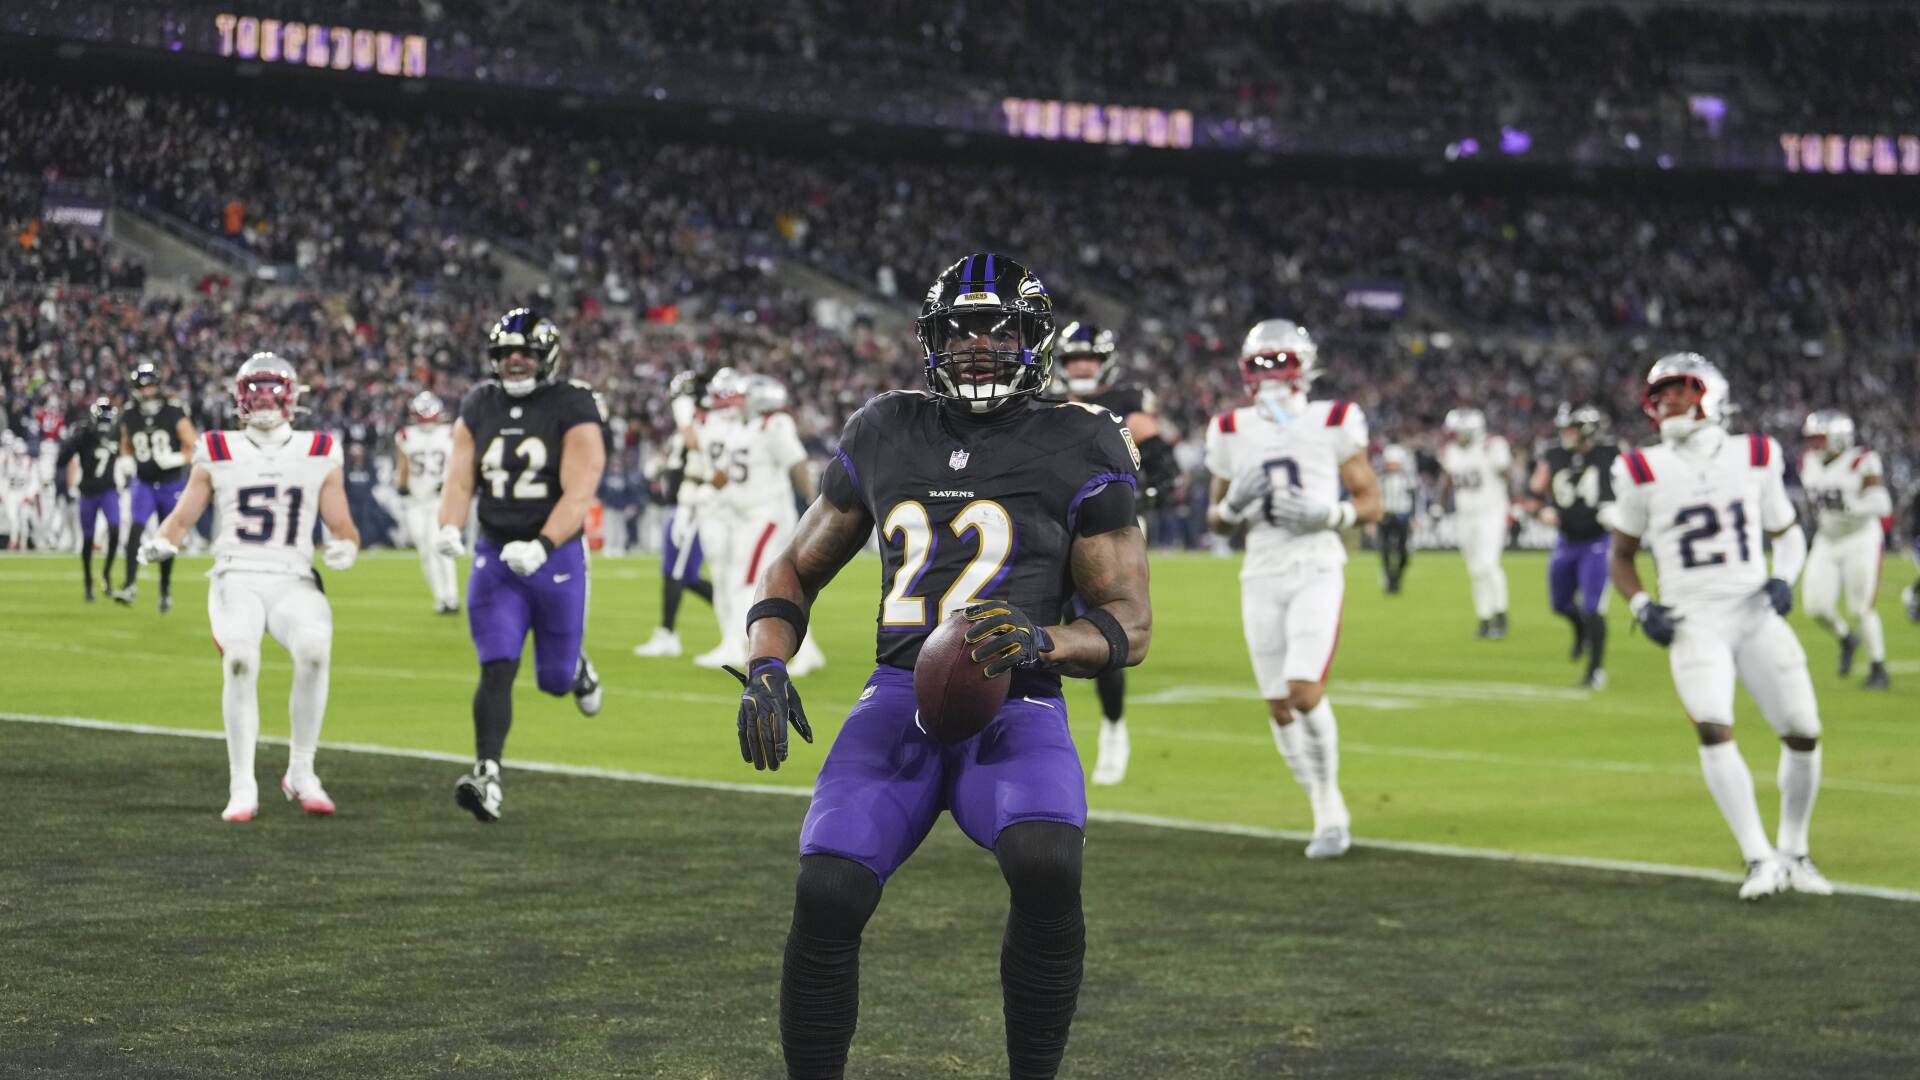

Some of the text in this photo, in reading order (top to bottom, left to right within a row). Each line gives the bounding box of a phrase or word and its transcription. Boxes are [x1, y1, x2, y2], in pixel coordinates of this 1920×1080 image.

[94, 451, 110, 478] 7
[481, 436, 547, 498] 42
[928, 490, 975, 498] RAVENS
[235, 485, 304, 546] 51
[1674, 499, 1749, 568] 21
[882, 500, 1016, 630] 22
